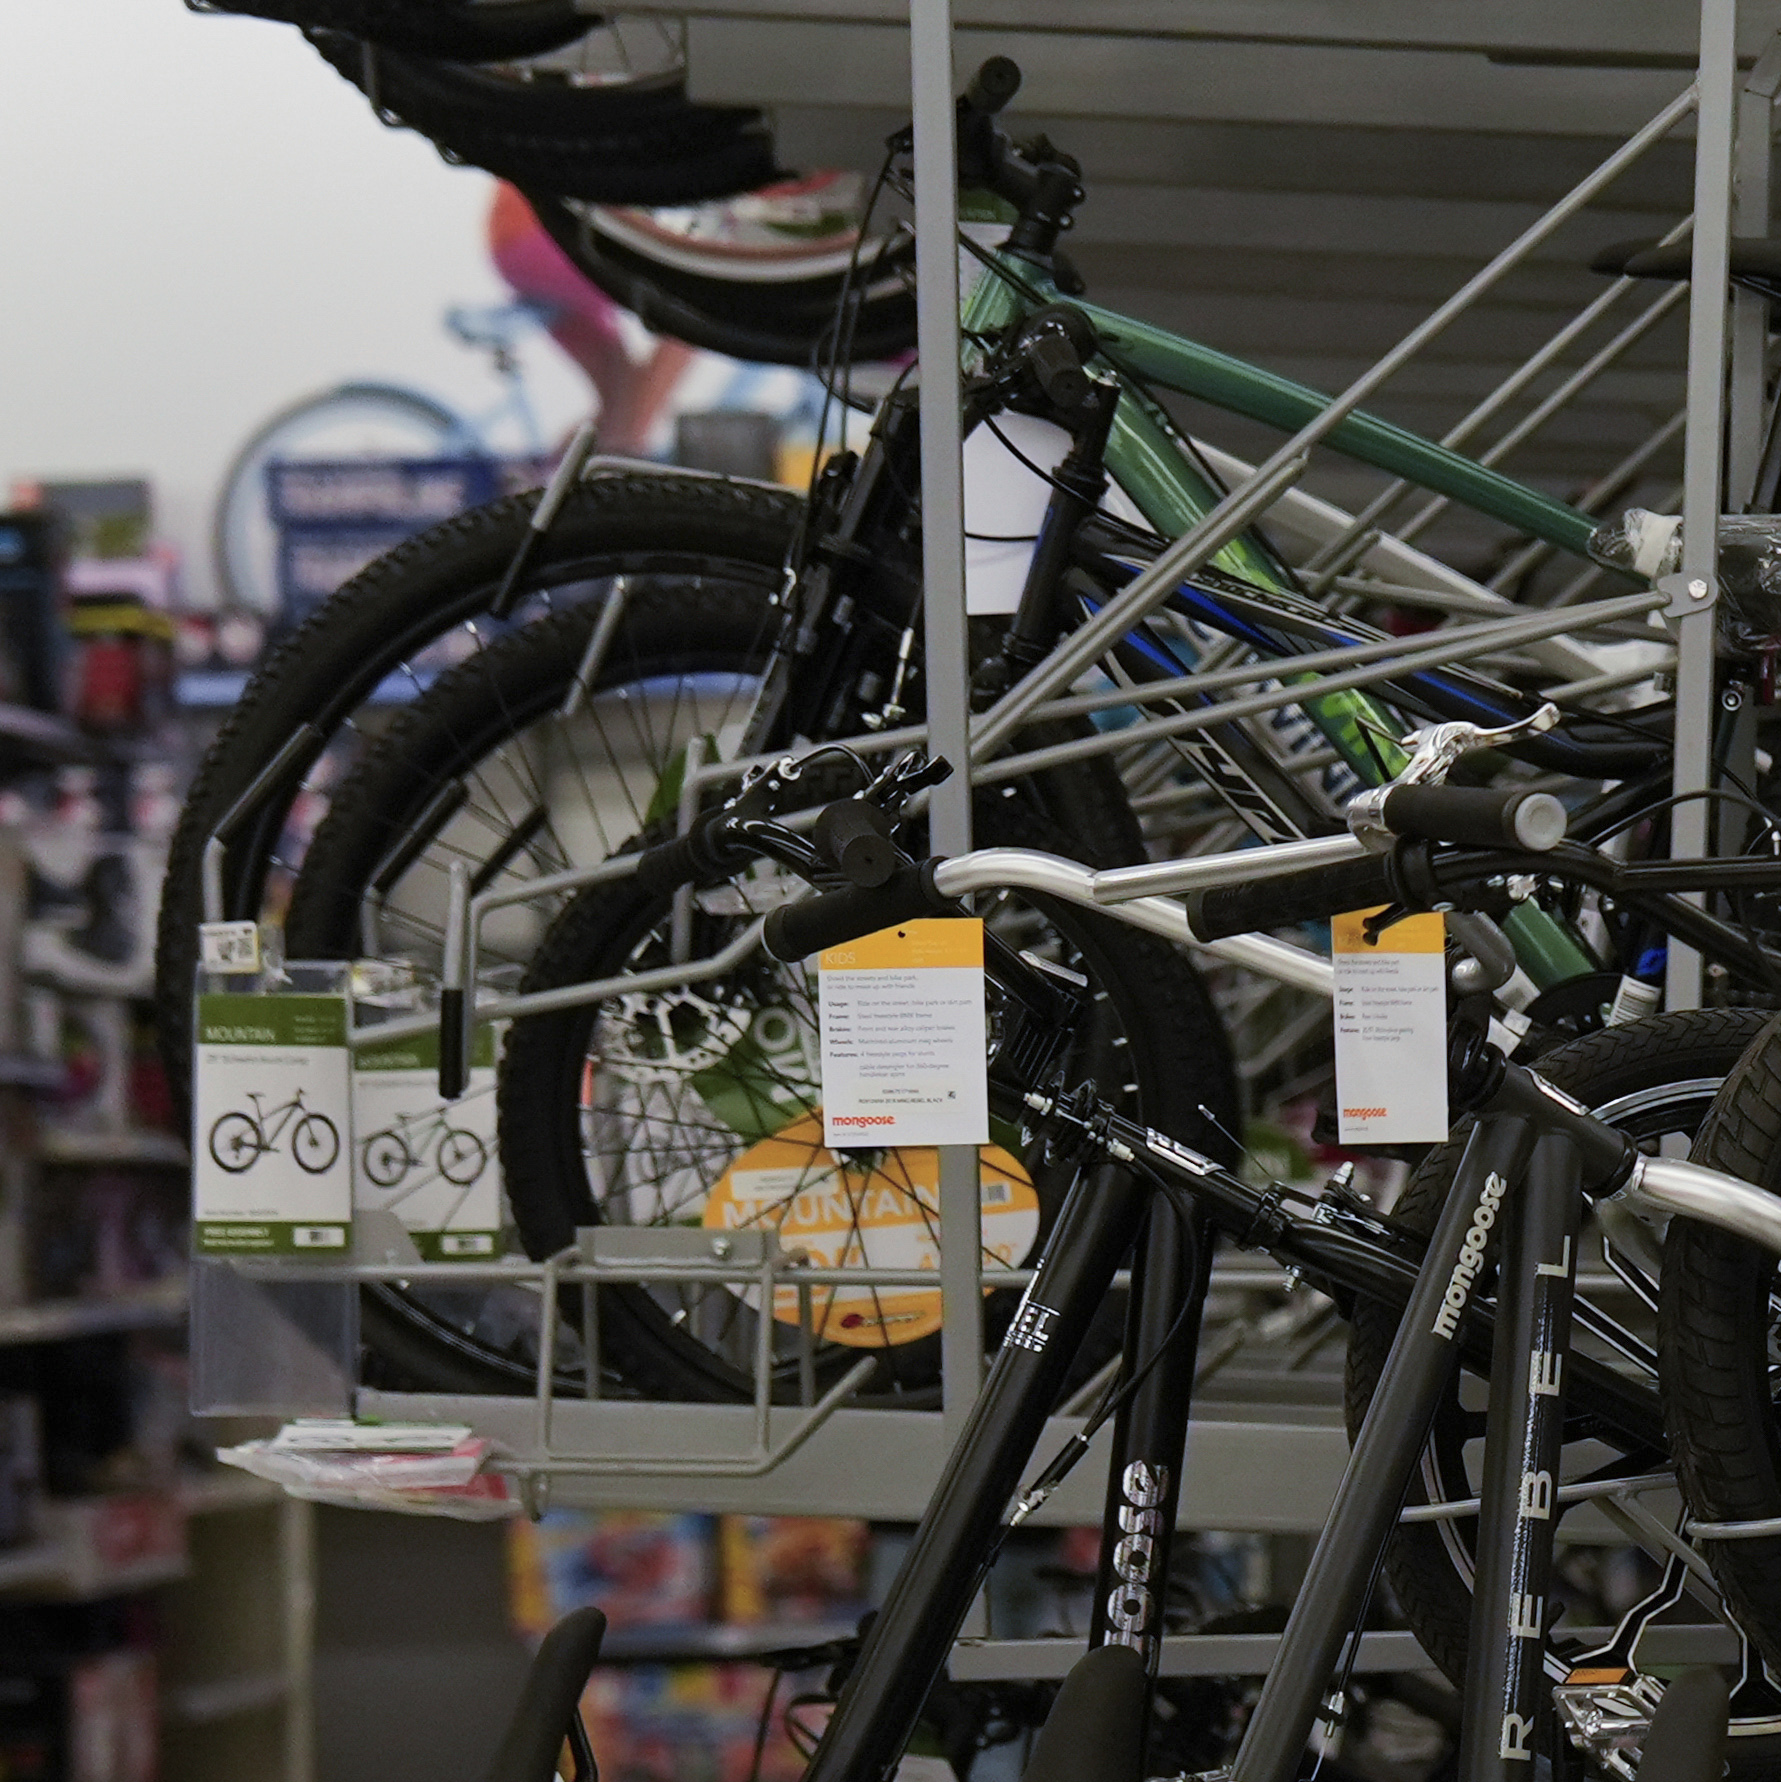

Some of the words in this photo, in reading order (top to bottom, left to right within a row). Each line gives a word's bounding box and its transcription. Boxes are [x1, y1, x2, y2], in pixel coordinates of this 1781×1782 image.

[826, 952, 855, 964] KIDS
[1343, 1107, 1387, 1120] mongoose
[832, 1116, 896, 1128] mongoose
[1431, 1171, 1508, 1341] mongoose
[1500, 1234, 1570, 1761] REBEL
